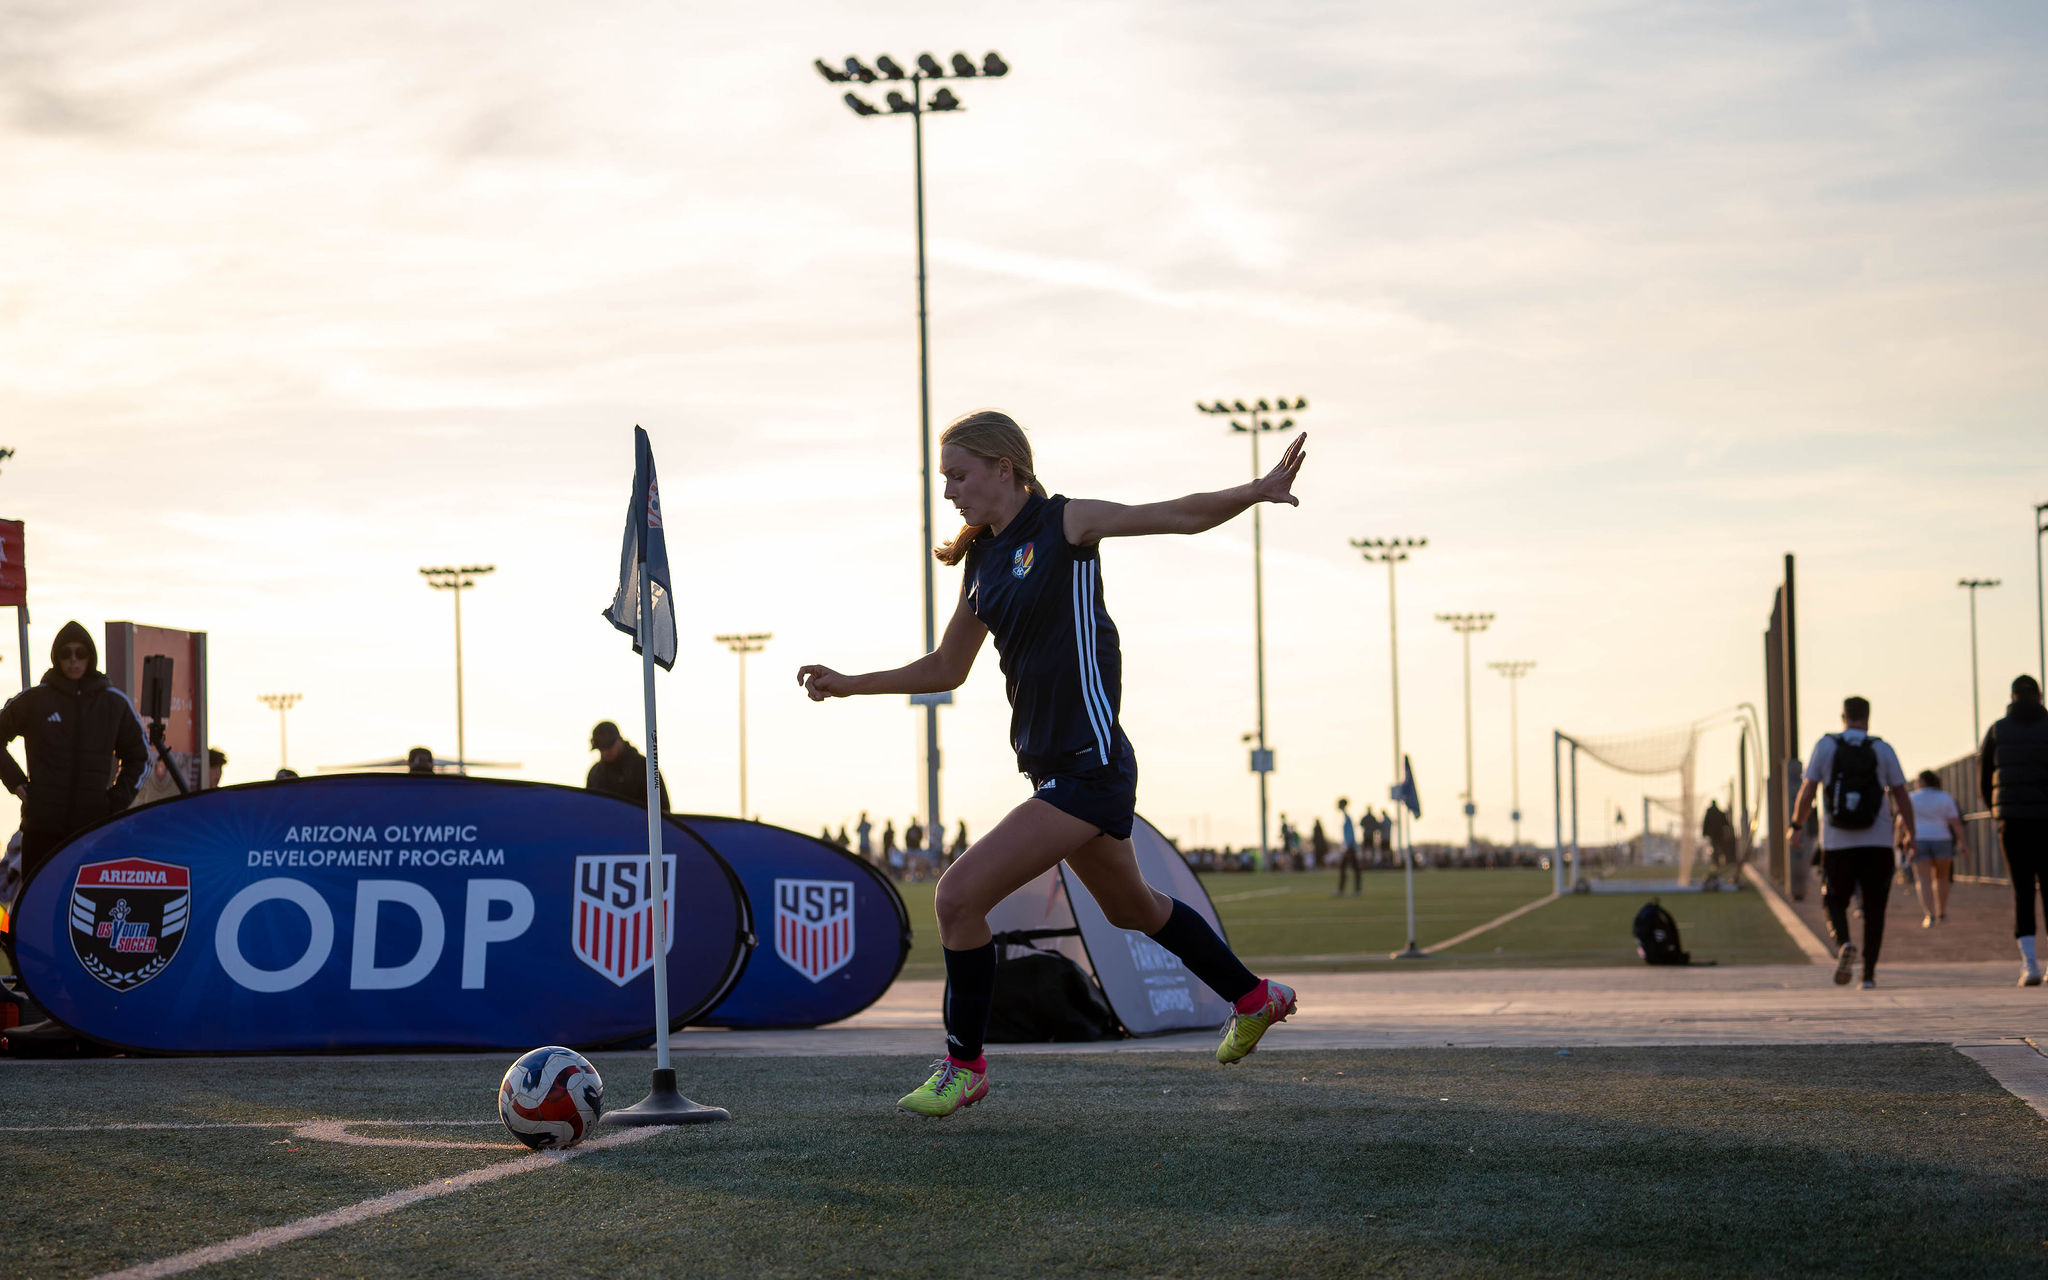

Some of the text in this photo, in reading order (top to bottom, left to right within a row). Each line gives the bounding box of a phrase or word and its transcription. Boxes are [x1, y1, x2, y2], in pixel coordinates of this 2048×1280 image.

[284, 825, 478, 843] ARIZONA OLYMPIC
[247, 849, 506, 867] DEVELOPMENT PROGRAM
[99, 869, 167, 884] ARIZONA
[781, 885, 849, 923] USA
[214, 876, 536, 994] ODP
[117, 937, 158, 952] SOCCER
